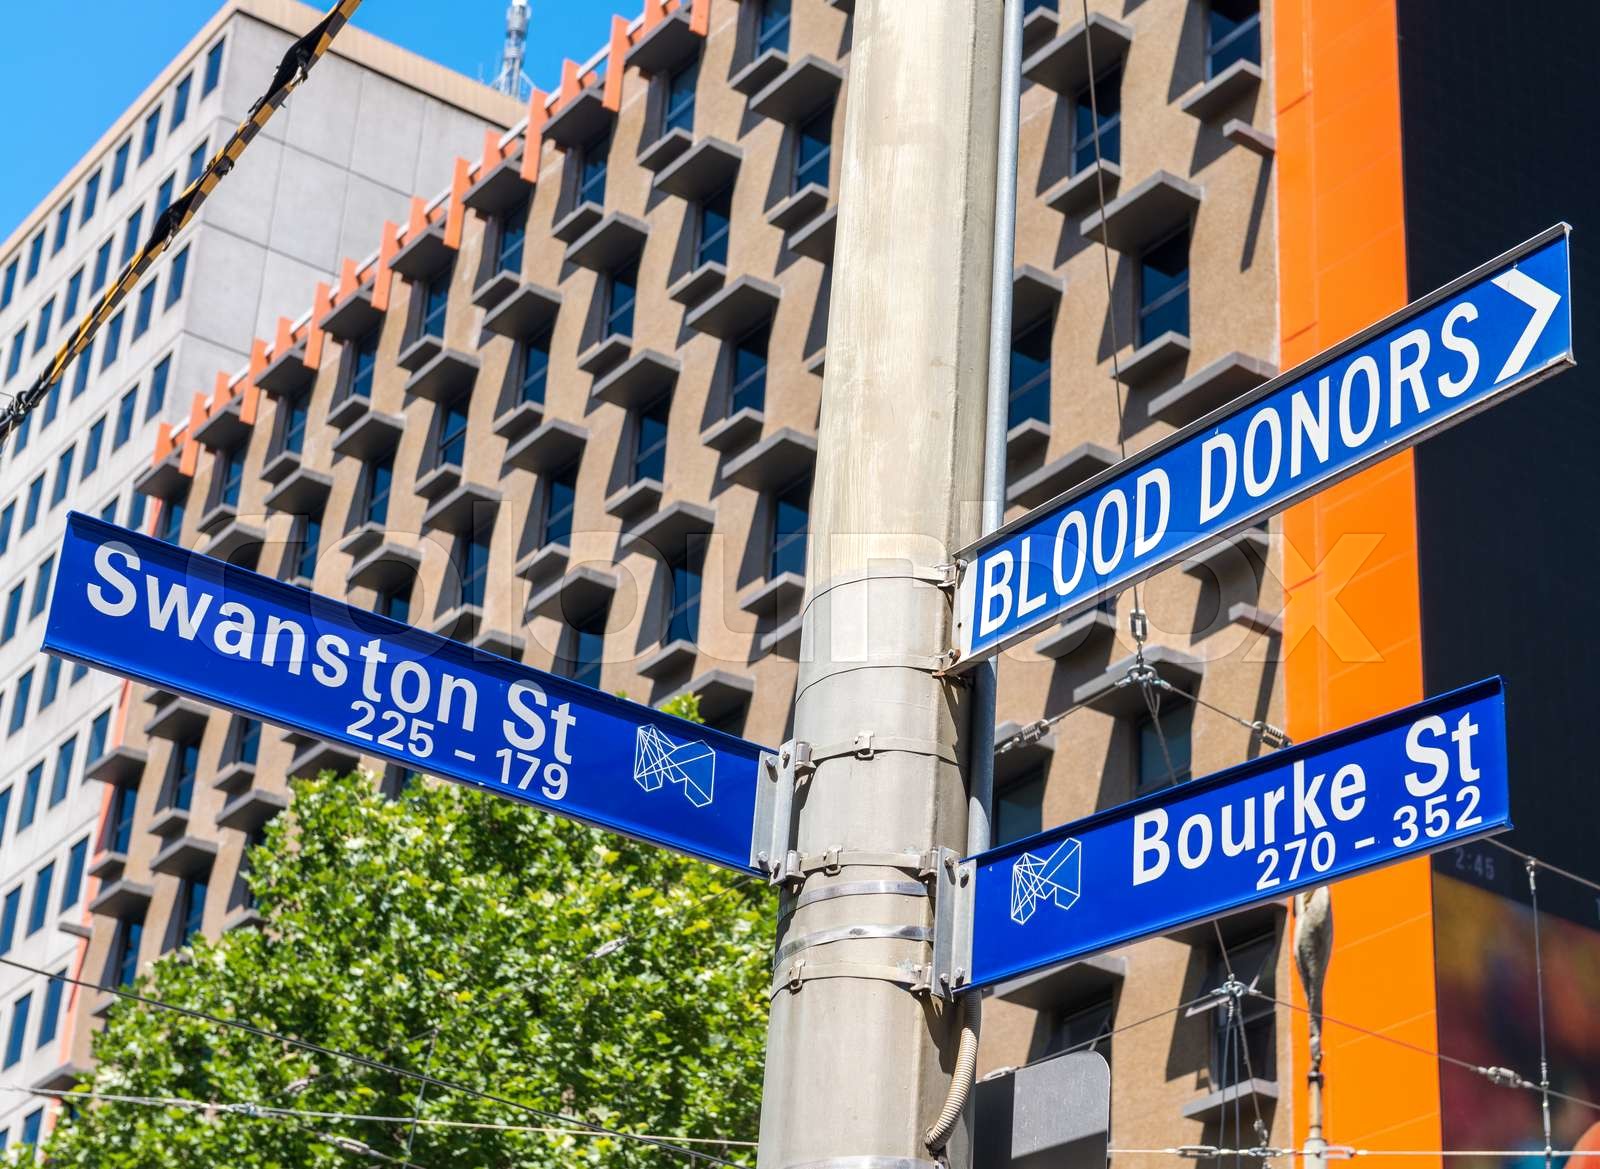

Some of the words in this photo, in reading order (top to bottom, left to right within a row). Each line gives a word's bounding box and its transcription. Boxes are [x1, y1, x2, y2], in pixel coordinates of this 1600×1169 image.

[979, 468, 1172, 639] BLOOD
[1199, 302, 1480, 525] DONORS
[87, 541, 479, 733] Swanston
[502, 680, 577, 766] St
[346, 700, 434, 759] 225
[495, 748, 569, 801] 179
[1132, 760, 1366, 886] Bourke
[1404, 712, 1481, 798] St
[1256, 831, 1337, 891] 270
[1392, 785, 1482, 848] 352
